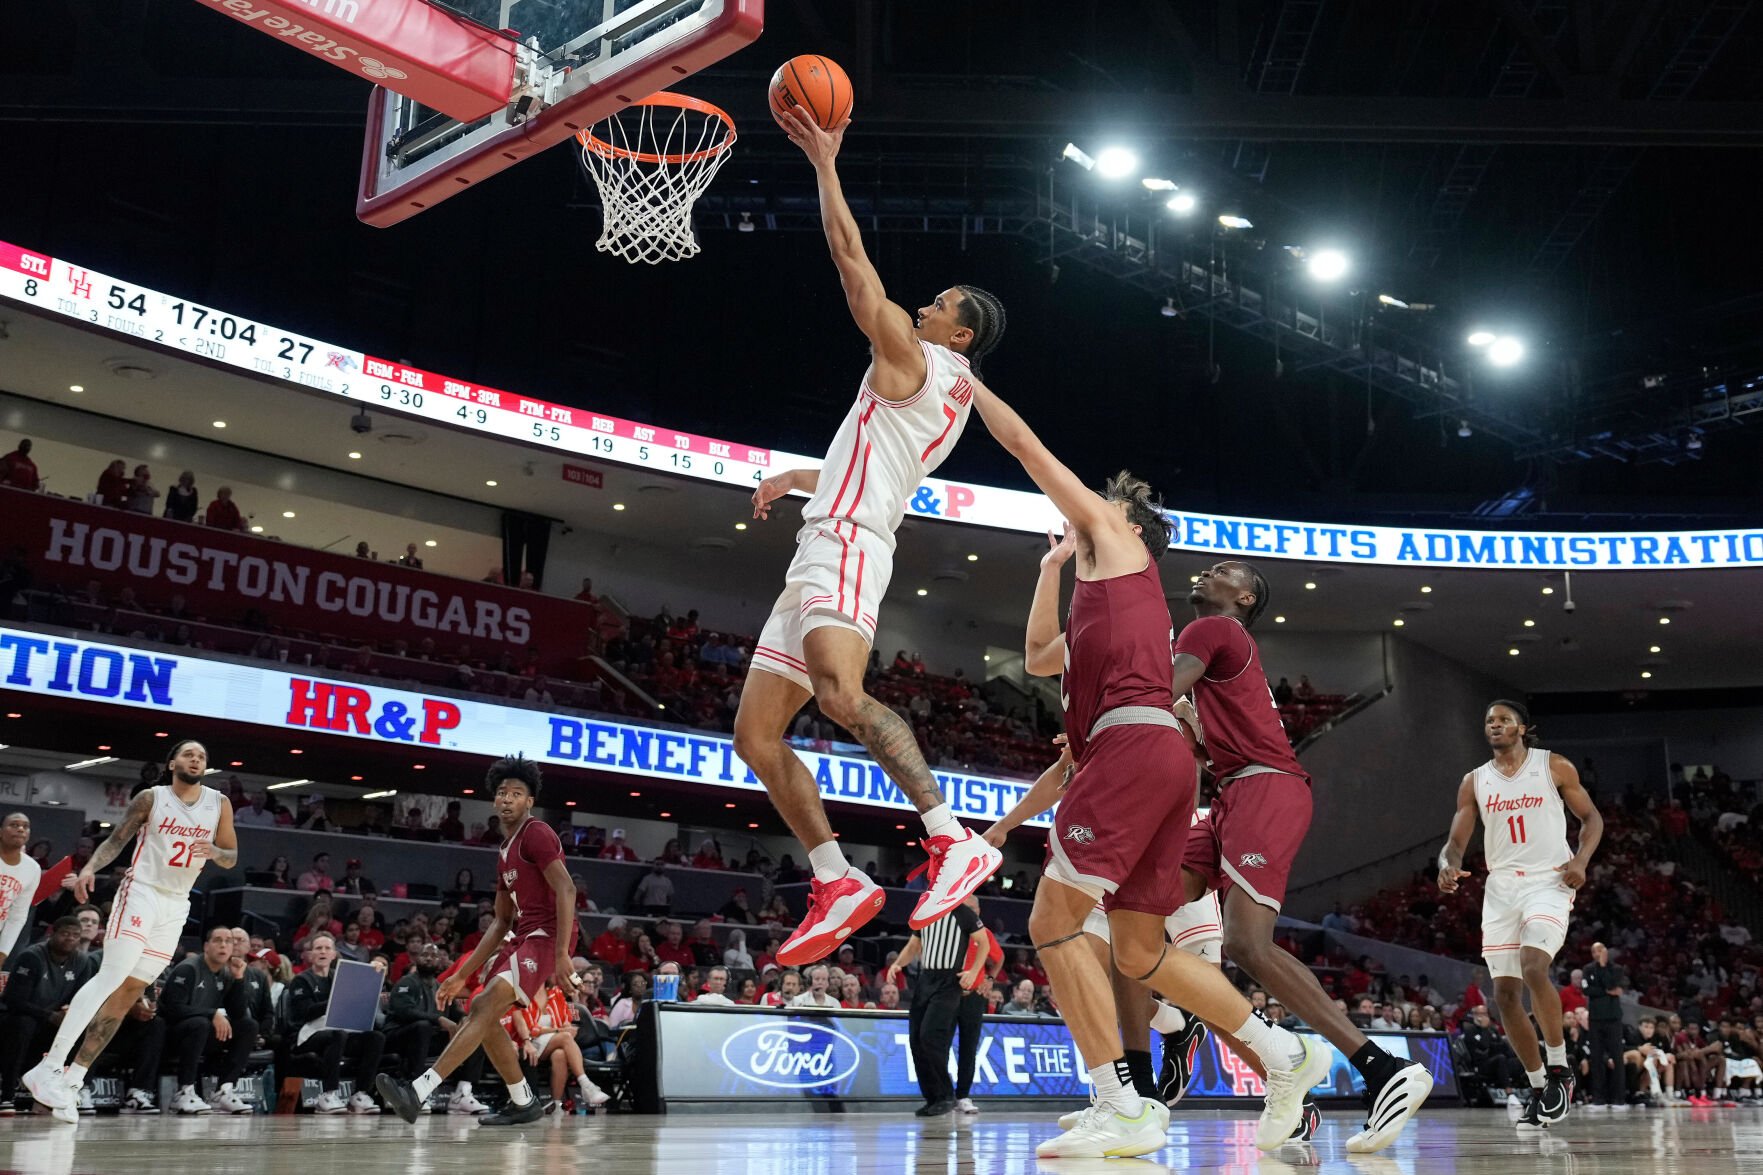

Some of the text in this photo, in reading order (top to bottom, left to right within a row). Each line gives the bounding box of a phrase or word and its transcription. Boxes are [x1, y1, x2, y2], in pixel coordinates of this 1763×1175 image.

[20, 253, 48, 275] STL
[25, 278, 38, 297] 8
[57, 297, 164, 341] TOL 3 FOULS 2
[107, 285, 314, 364] 54 17:04 27
[195, 337, 226, 359] 2ND
[282, 367, 291, 379] 3
[341, 383, 349, 395] 2
[591, 416, 615, 433] REB
[633, 426, 656, 443] AST
[674, 434, 691, 450] TO
[708, 441, 731, 458] BLK
[747, 449, 768, 465] STL
[920, 402, 957, 463] 7
[592, 436, 614, 453] 19
[639, 446, 649, 460] 5
[670, 452, 692, 469] 15
[714, 461, 724, 475] 0
[752, 470, 763, 482] 4
[903, 484, 975, 519] &P
[1396, 533, 1763, 565] ADMINISTRATIO
[45, 518, 532, 645] HOUSTON COUGARS
[0, 634, 178, 706] TION
[286, 677, 461, 745] HR&P
[547, 717, 758, 784] BENEFI
[1485, 793, 1543, 814] Houston
[158, 817, 211, 839] Houston
[1507, 815, 1526, 844] 11
[168, 841, 196, 869] 21
[750, 1030, 834, 1077] Ford
[894, 1034, 1030, 1084] TKE
[1030, 1048, 1073, 1074] THE
